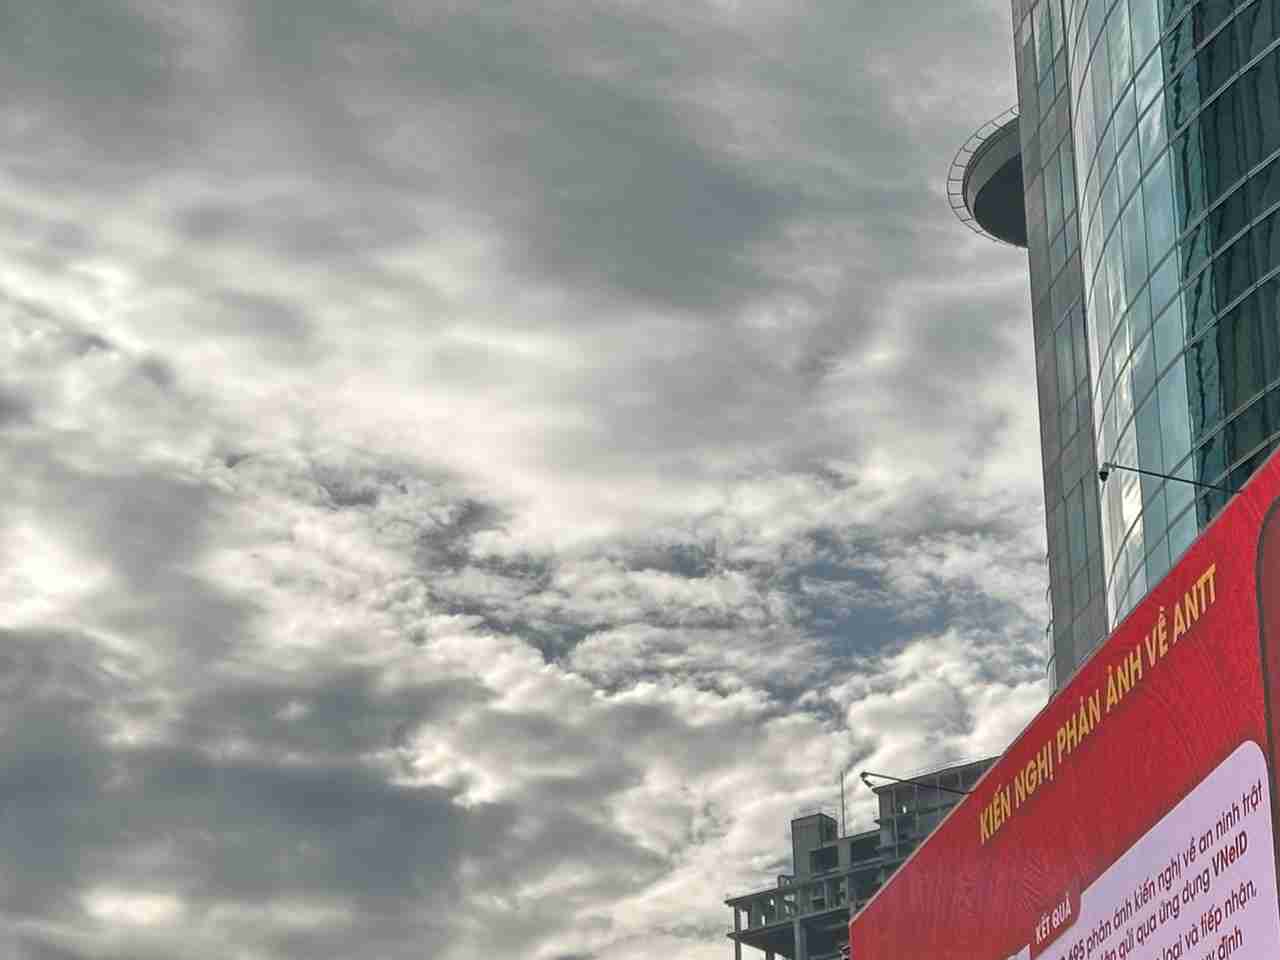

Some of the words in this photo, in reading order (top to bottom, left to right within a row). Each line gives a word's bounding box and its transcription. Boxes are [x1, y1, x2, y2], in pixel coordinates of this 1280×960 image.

[980, 782, 1012, 844] KIẾN
[1014, 741, 1054, 809] NGHỊ
[1172, 562, 1217, 643] ANTT
[1212, 831, 1247, 876] VNeID
